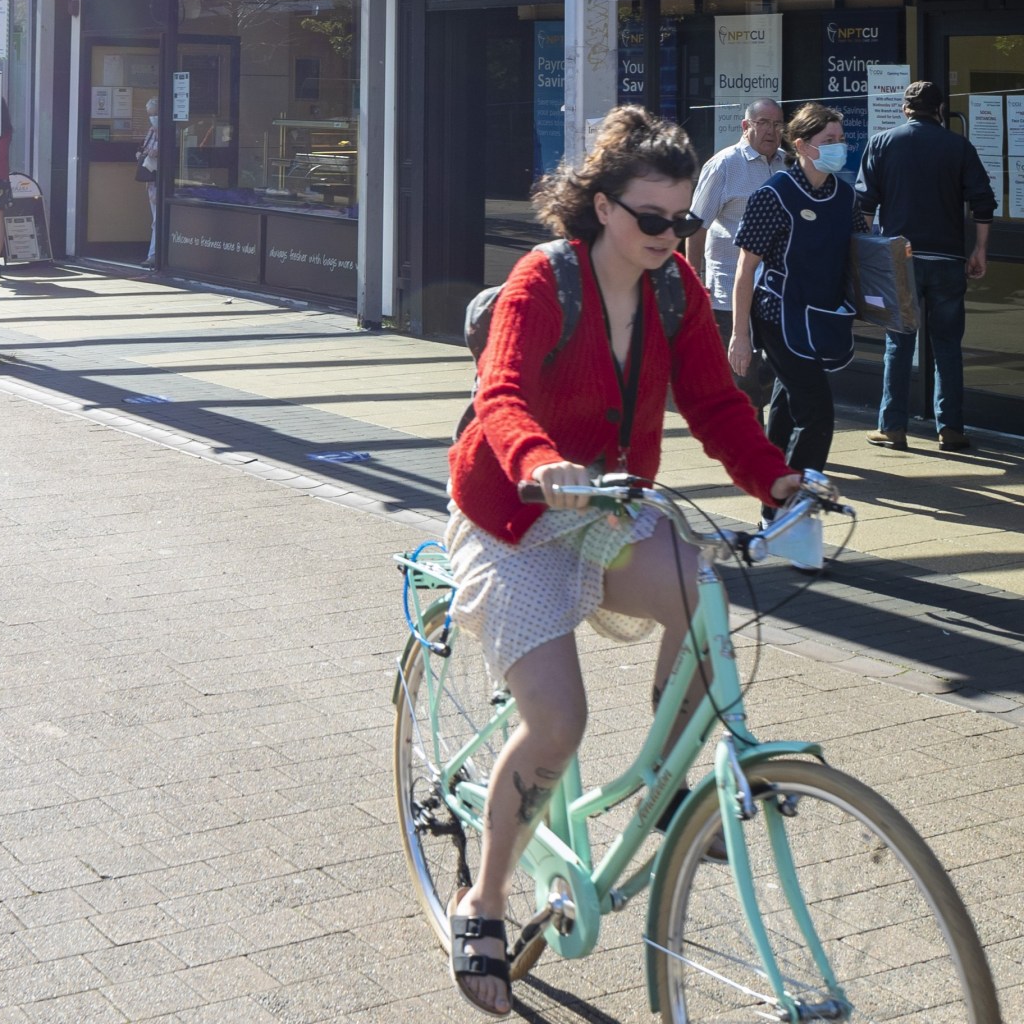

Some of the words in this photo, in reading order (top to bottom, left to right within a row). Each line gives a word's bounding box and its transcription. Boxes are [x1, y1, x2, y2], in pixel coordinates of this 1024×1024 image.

[728, 30, 765, 41] NPTCU
[838, 27, 879, 39] NPTCU
[538, 56, 566, 75] Payro
[719, 73, 779, 93] Budgeting
[828, 76, 840, 93] &
[843, 76, 868, 93] Loa
[308, 253, 322, 265] with
[322, 254, 338, 272] bags
[338, 260, 354, 270] more
